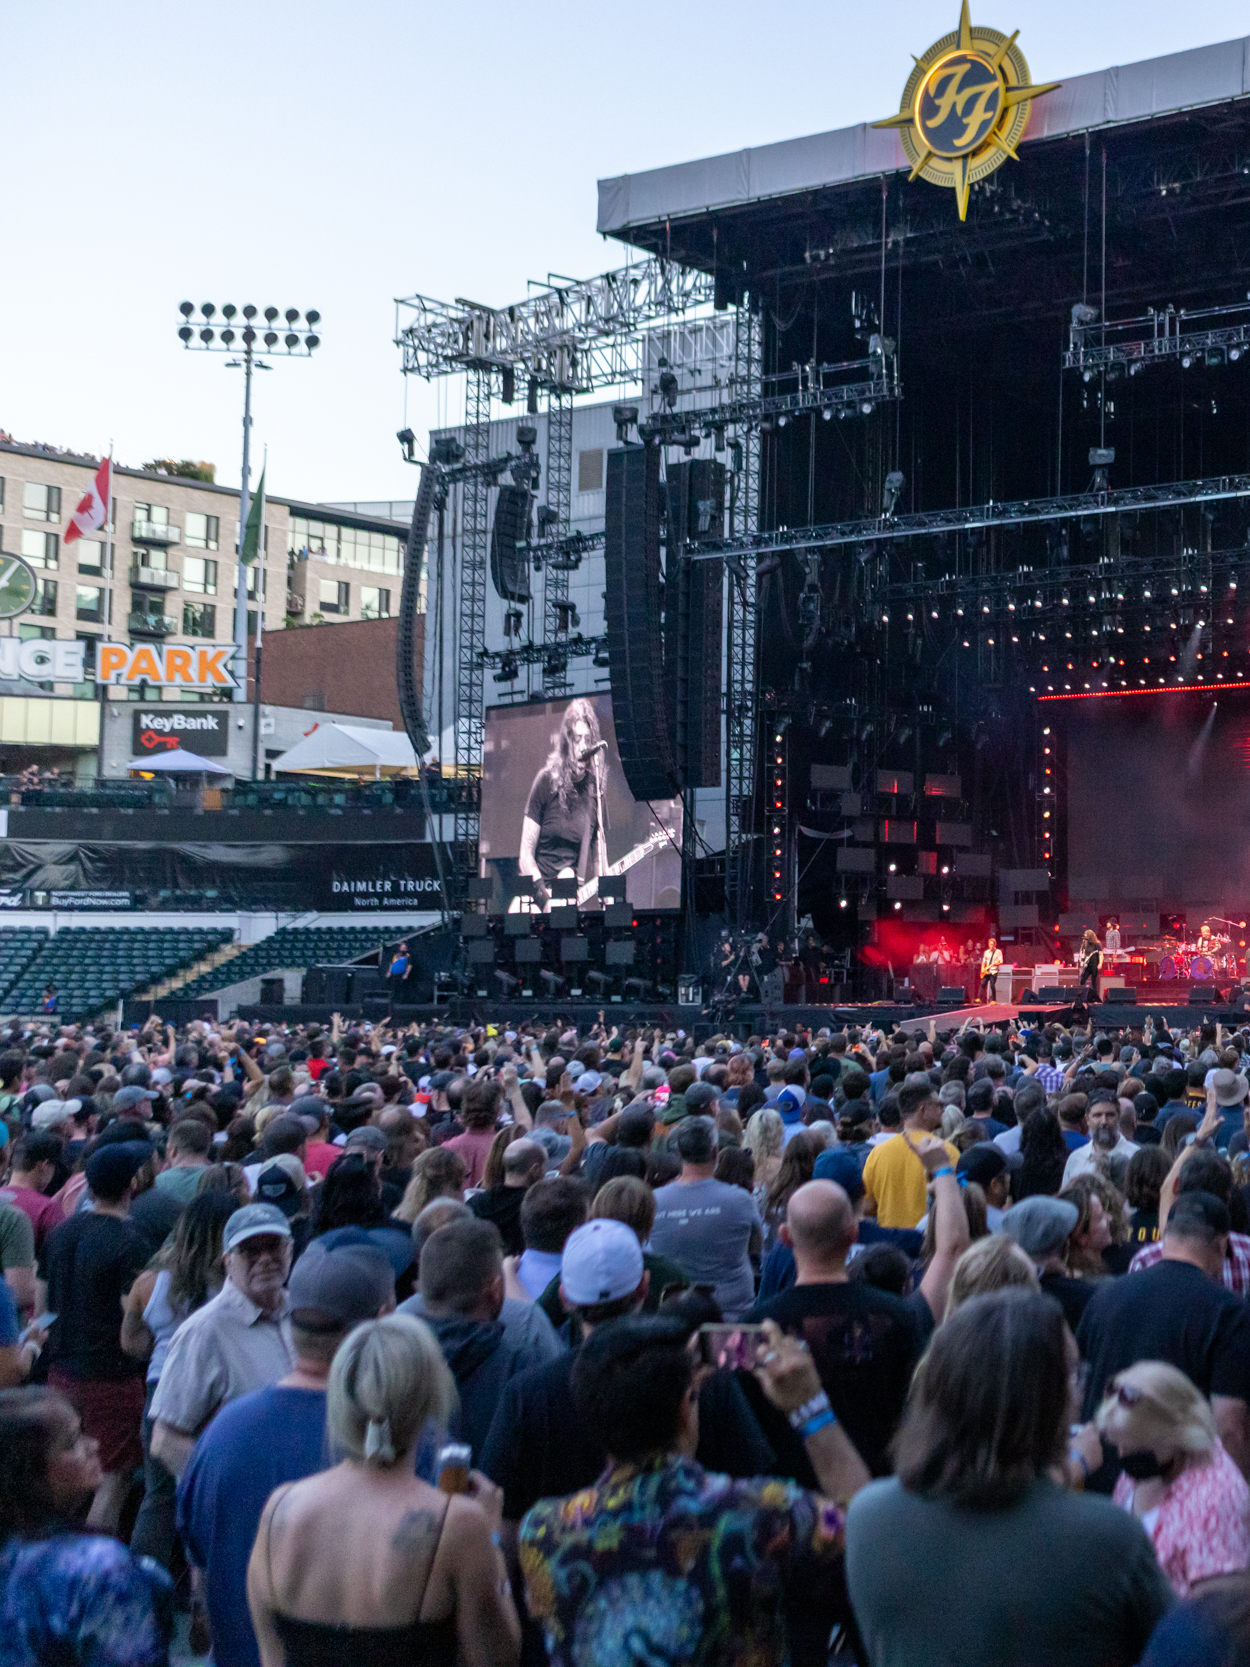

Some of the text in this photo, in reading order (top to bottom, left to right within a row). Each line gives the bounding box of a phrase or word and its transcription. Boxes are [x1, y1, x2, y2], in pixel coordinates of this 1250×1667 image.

[100, 646, 228, 684] PARK
[140, 713, 219, 733] KeyBank
[332, 880, 441, 893] DAIMLER TRUCK
[51, 896, 131, 907] BuyFordNow.com
[354, 897, 418, 906] North America
